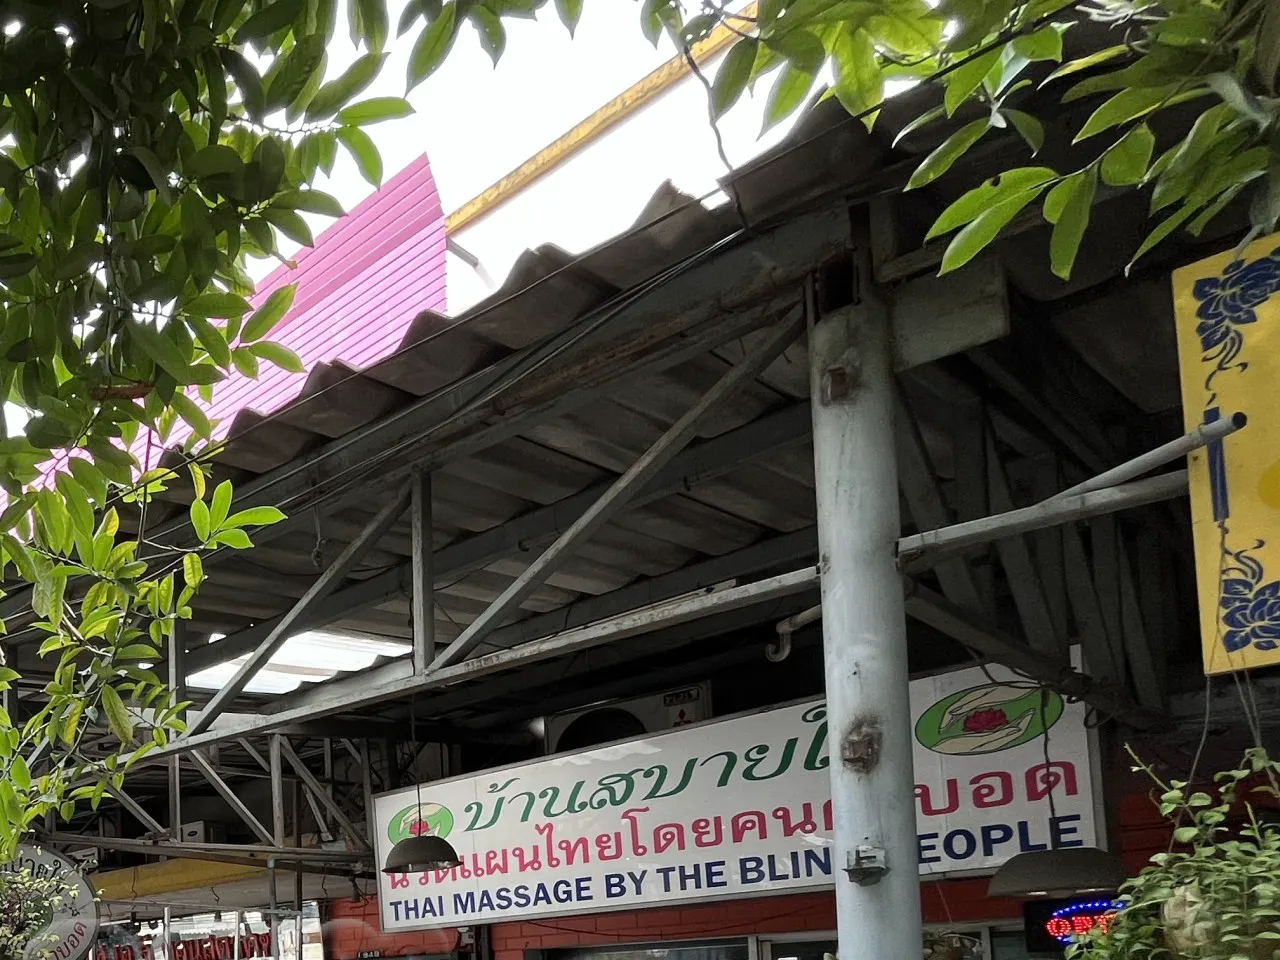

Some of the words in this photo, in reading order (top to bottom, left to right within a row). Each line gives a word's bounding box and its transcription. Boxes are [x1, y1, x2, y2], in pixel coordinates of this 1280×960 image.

[464, 703, 830, 832] บ้านสบายใ
[389, 896, 444, 922] THAI
[453, 877, 594, 915] MASSAGE
[605, 869, 648, 899] BY
[656, 860, 727, 893] THE
[739, 848, 831, 884] BLIN
[918, 813, 1083, 865] EOPLE
